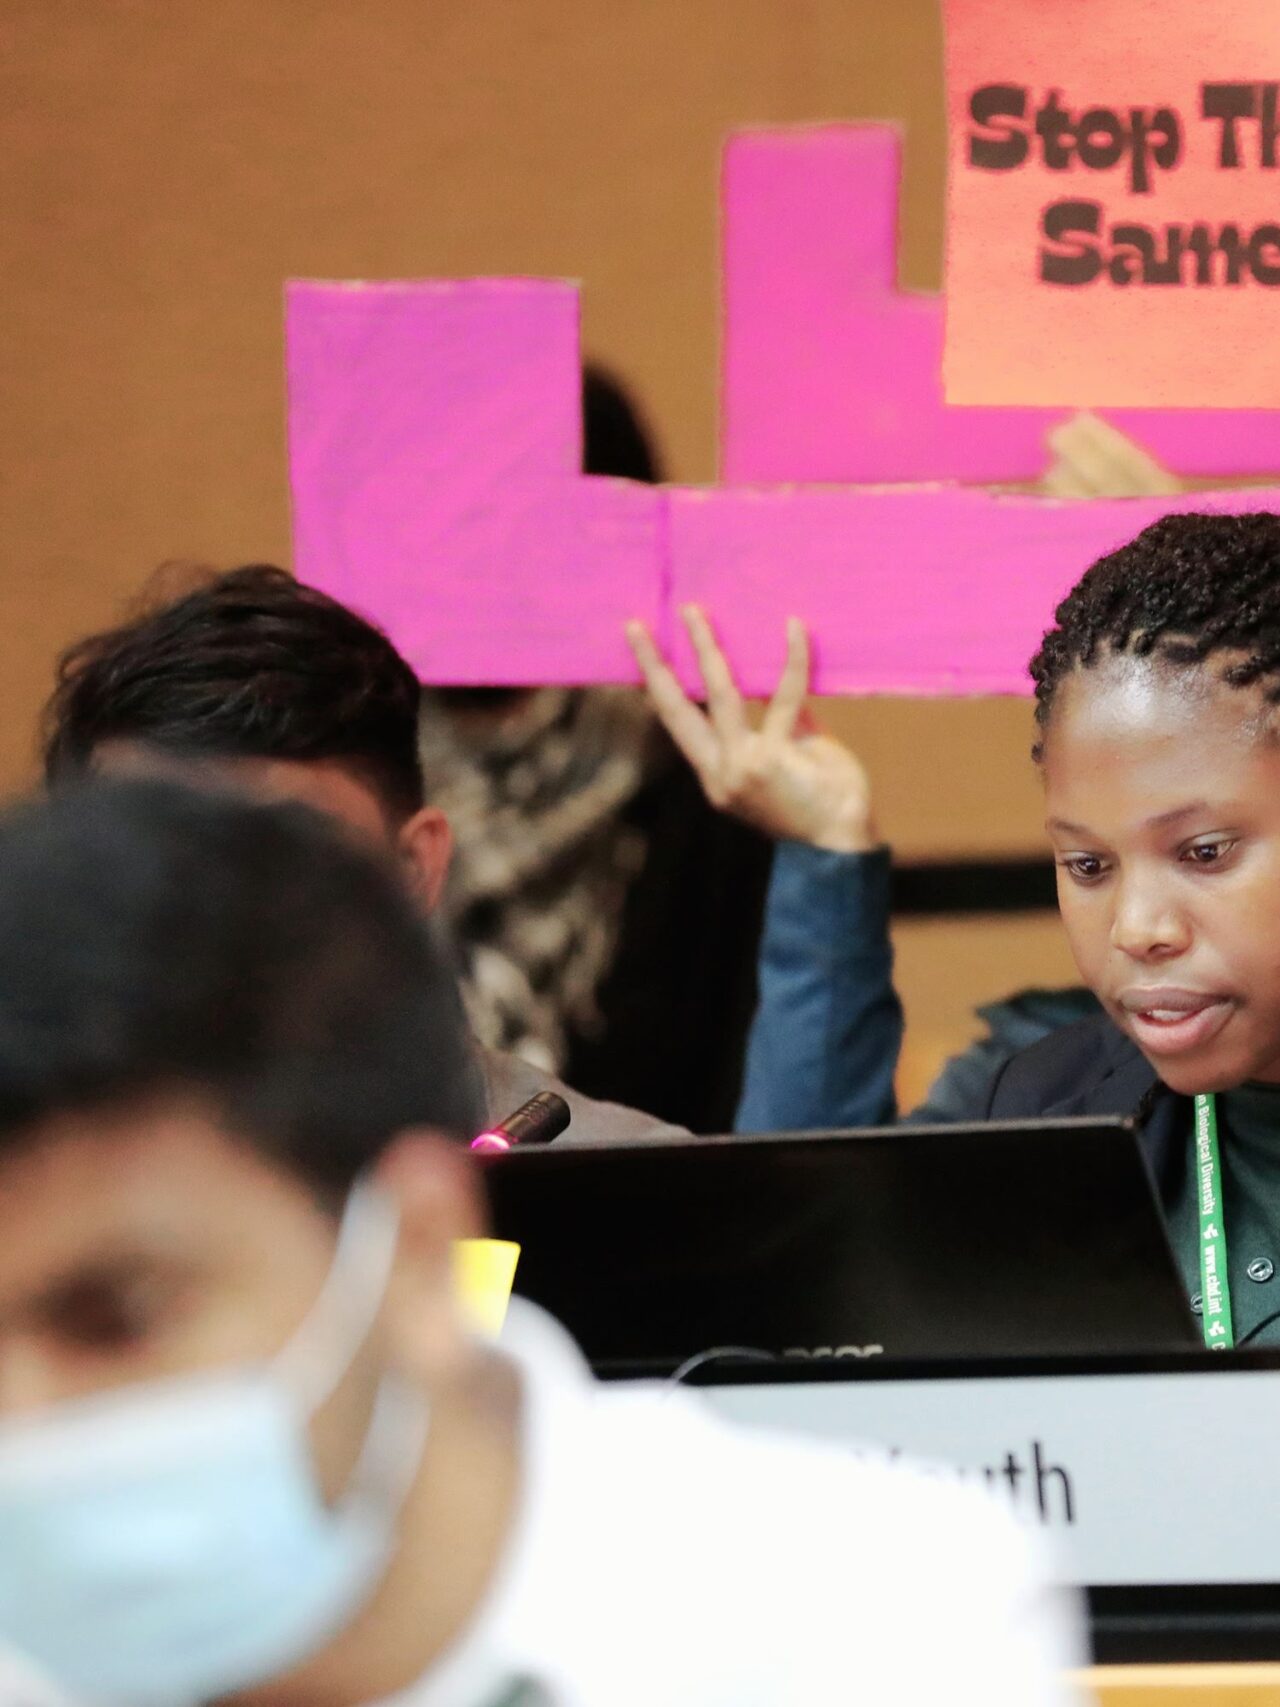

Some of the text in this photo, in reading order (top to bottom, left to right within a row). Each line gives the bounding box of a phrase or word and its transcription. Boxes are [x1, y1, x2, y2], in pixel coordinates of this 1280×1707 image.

[968, 83, 1180, 193] Stop
[1198, 1105, 1213, 1163] Biological
[1201, 1162, 1216, 1215] Diversity
